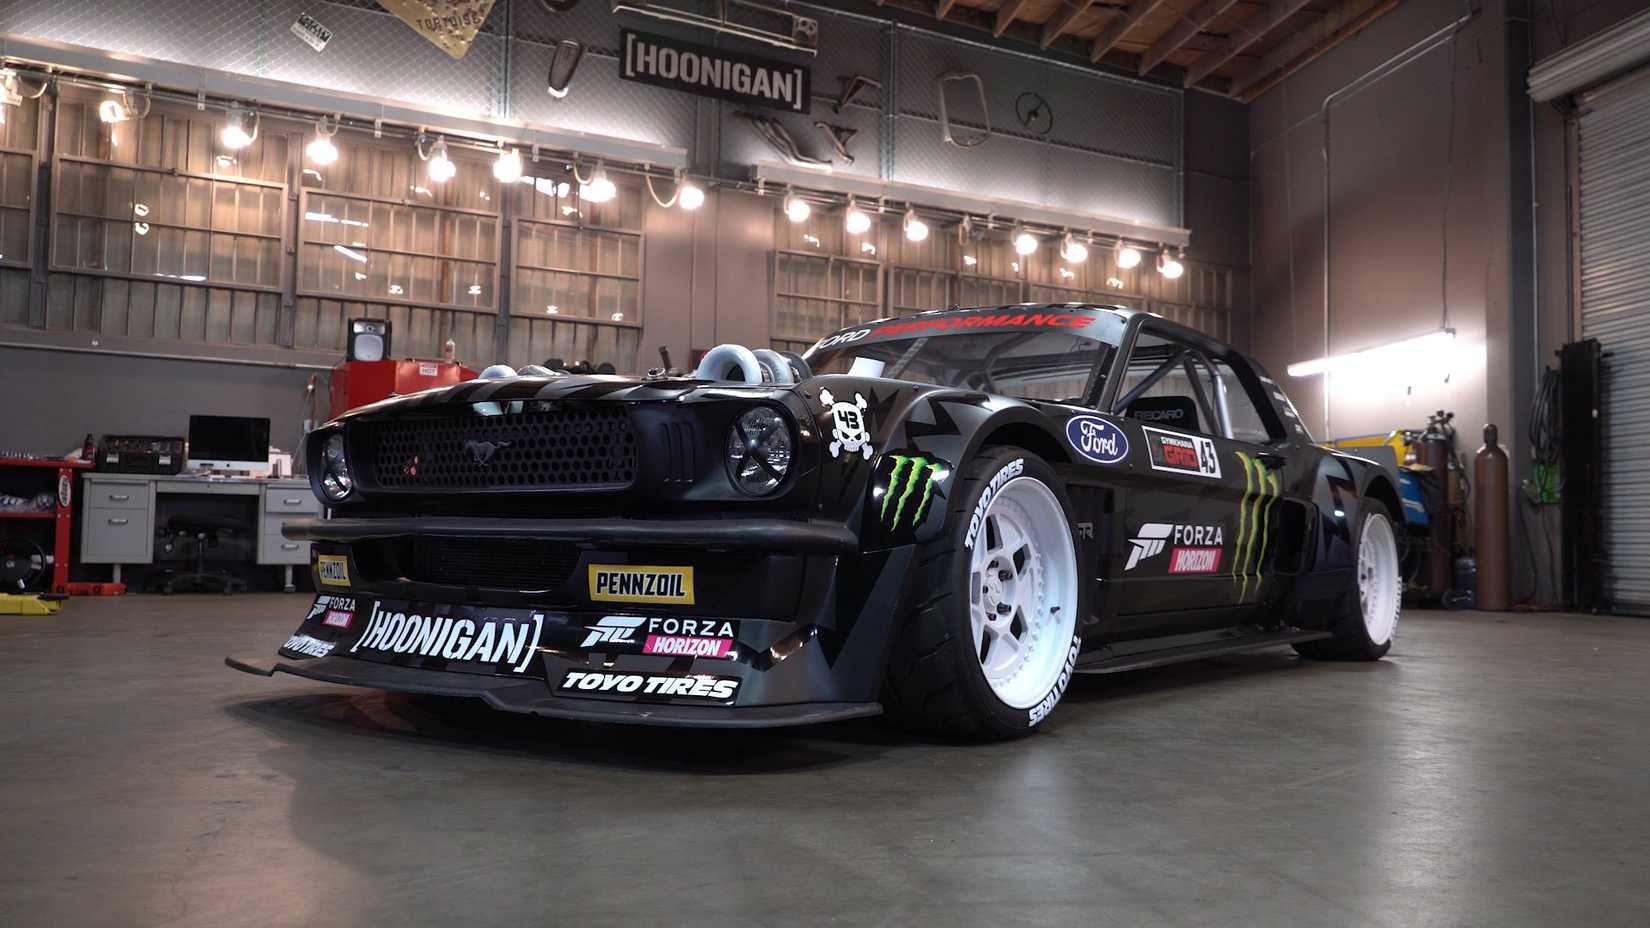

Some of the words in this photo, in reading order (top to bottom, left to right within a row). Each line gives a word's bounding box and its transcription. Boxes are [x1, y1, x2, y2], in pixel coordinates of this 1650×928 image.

[625, 32, 803, 110] [HOONIGAN]
[871, 313, 1096, 337] PERFORMANCE
[837, 409, 860, 429] 43
[1135, 408, 1184, 421] RECARO
[1080, 420, 1119, 456] Ford
[1200, 440, 1217, 474] 43
[964, 486, 992, 550] TOYO
[989, 458, 1024, 496] TIRES
[1173, 524, 1224, 546] FORZA
[1174, 550, 1216, 571] HORIZON
[596, 571, 688, 598] PENNZOIL
[329, 596, 356, 612] FORZA
[351, 600, 545, 673] [HOONIGAN]
[648, 618, 734, 638] FORZA
[653, 637, 722, 656] HORIZON
[1057, 635, 1082, 694] TOYO
[562, 672, 645, 693] TOYO
[643, 675, 739, 699] TIRES
[1028, 686, 1060, 727] TIRES
